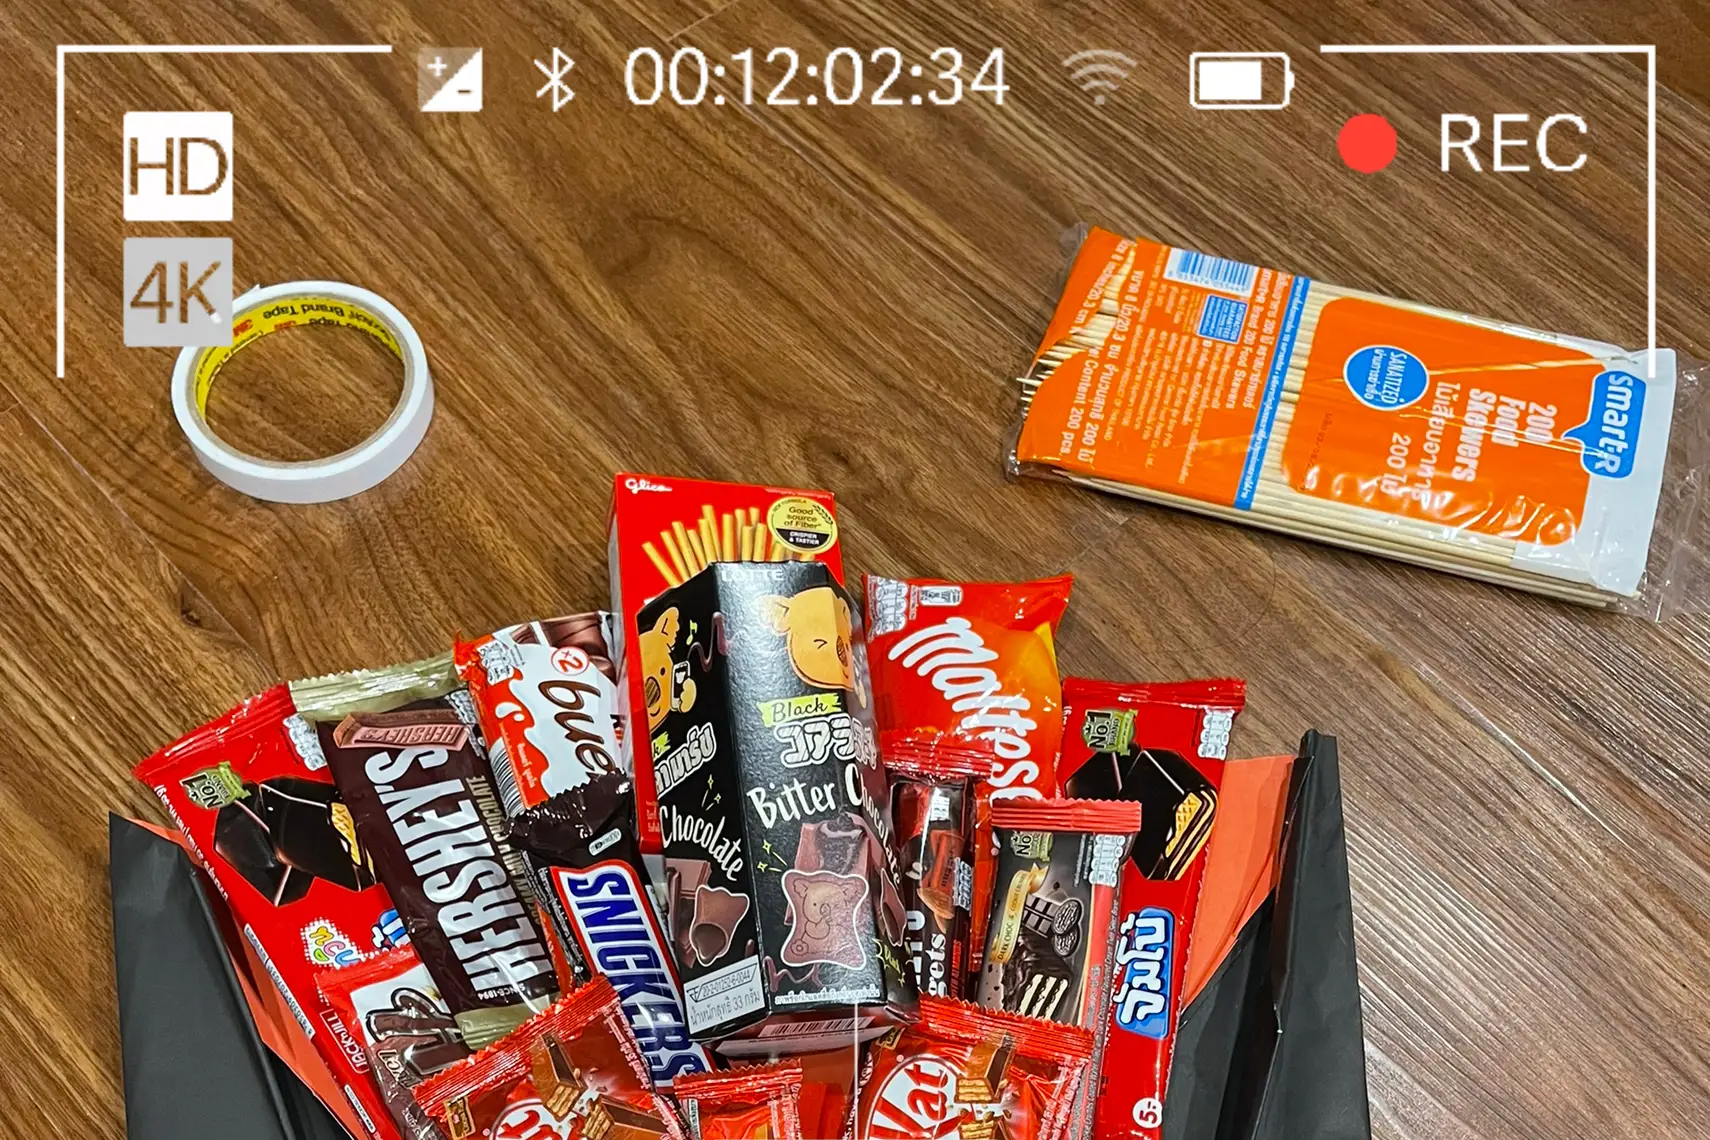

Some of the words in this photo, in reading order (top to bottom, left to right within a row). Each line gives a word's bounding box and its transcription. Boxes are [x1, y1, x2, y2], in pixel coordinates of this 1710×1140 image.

[261, 300, 297, 324] Tape
[299, 300, 344, 318] Brand
[1236, 345, 1252, 368] Food
[1072, 358, 1097, 406] Content
[1225, 368, 1245, 409] Skewers
[1379, 351, 1408, 405] SANATIZED
[1065, 406, 1083, 431] 200
[1080, 421, 1098, 445] 200
[1450, 387, 1494, 482] Skewers
[1489, 394, 1527, 447] Food
[1525, 401, 1559, 444] 200
[1055, 430, 1074, 457] pcs.
[1386, 432, 1412, 470] 200
[625, 478, 673, 494] Glico
[783, 519, 794, 528] of
[786, 514, 818, 523] source
[788, 506, 814, 516] Good
[721, 568, 785, 583] LOTTE
[771, 697, 828, 723] Black
[1086, 709, 1113, 749] No.1
[180, 772, 225, 810] No.1
[747, 778, 837, 829] Bitter
[659, 805, 744, 882] Chocolate
[364, 746, 560, 1003] HERSHEY'S
[566, 873, 704, 1086] SNICKERS
